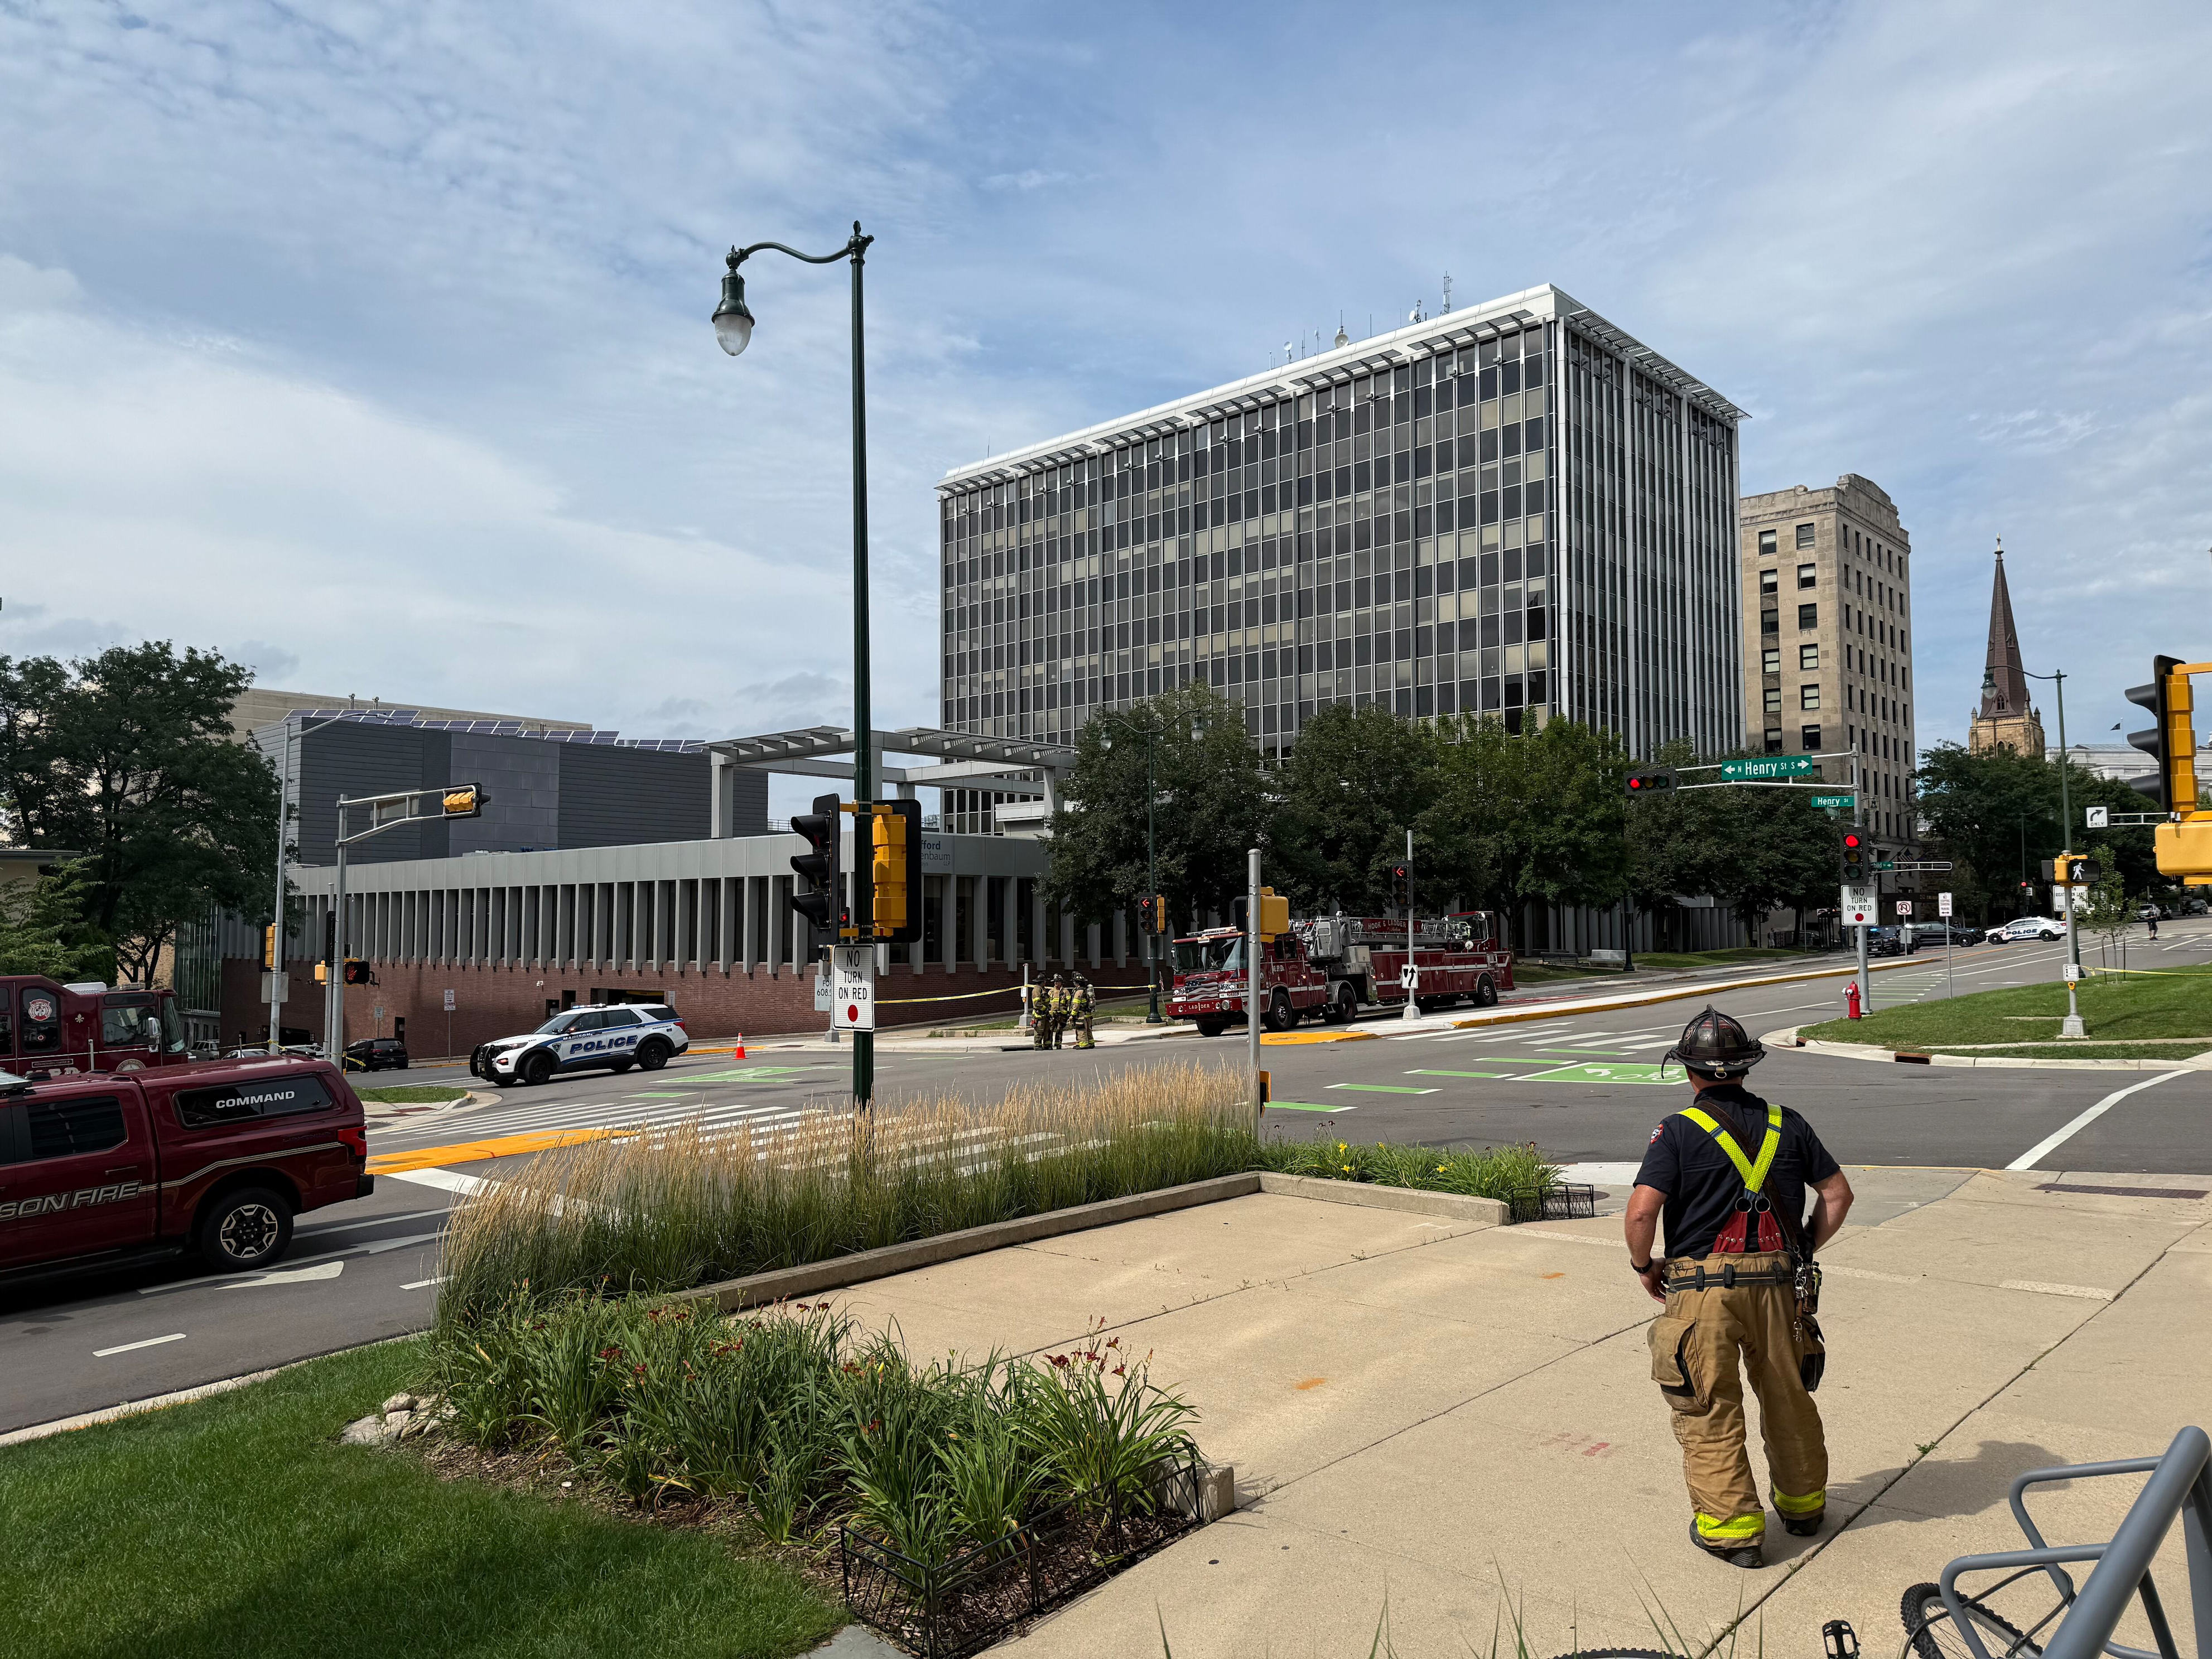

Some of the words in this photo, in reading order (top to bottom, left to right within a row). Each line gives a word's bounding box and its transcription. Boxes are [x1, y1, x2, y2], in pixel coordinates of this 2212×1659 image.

[1745, 761, 1777, 777] Henry
[1818, 798, 1840, 807] Henry
[1853, 888, 1864, 896] NO
[1368, 922, 1381, 930] HOOK
[1387, 919, 1406, 928] LADDER
[847, 950, 860, 967] NO
[844, 971, 862, 983] TURN
[838, 987, 848, 999] ON
[852, 987, 867, 1000] RED
[563, 1033, 591, 1041] MADISON
[570, 1035, 638, 1054] POLICE
[215, 1091, 295, 1109] COMMAND
[71, 1180, 142, 1209] FIRE
